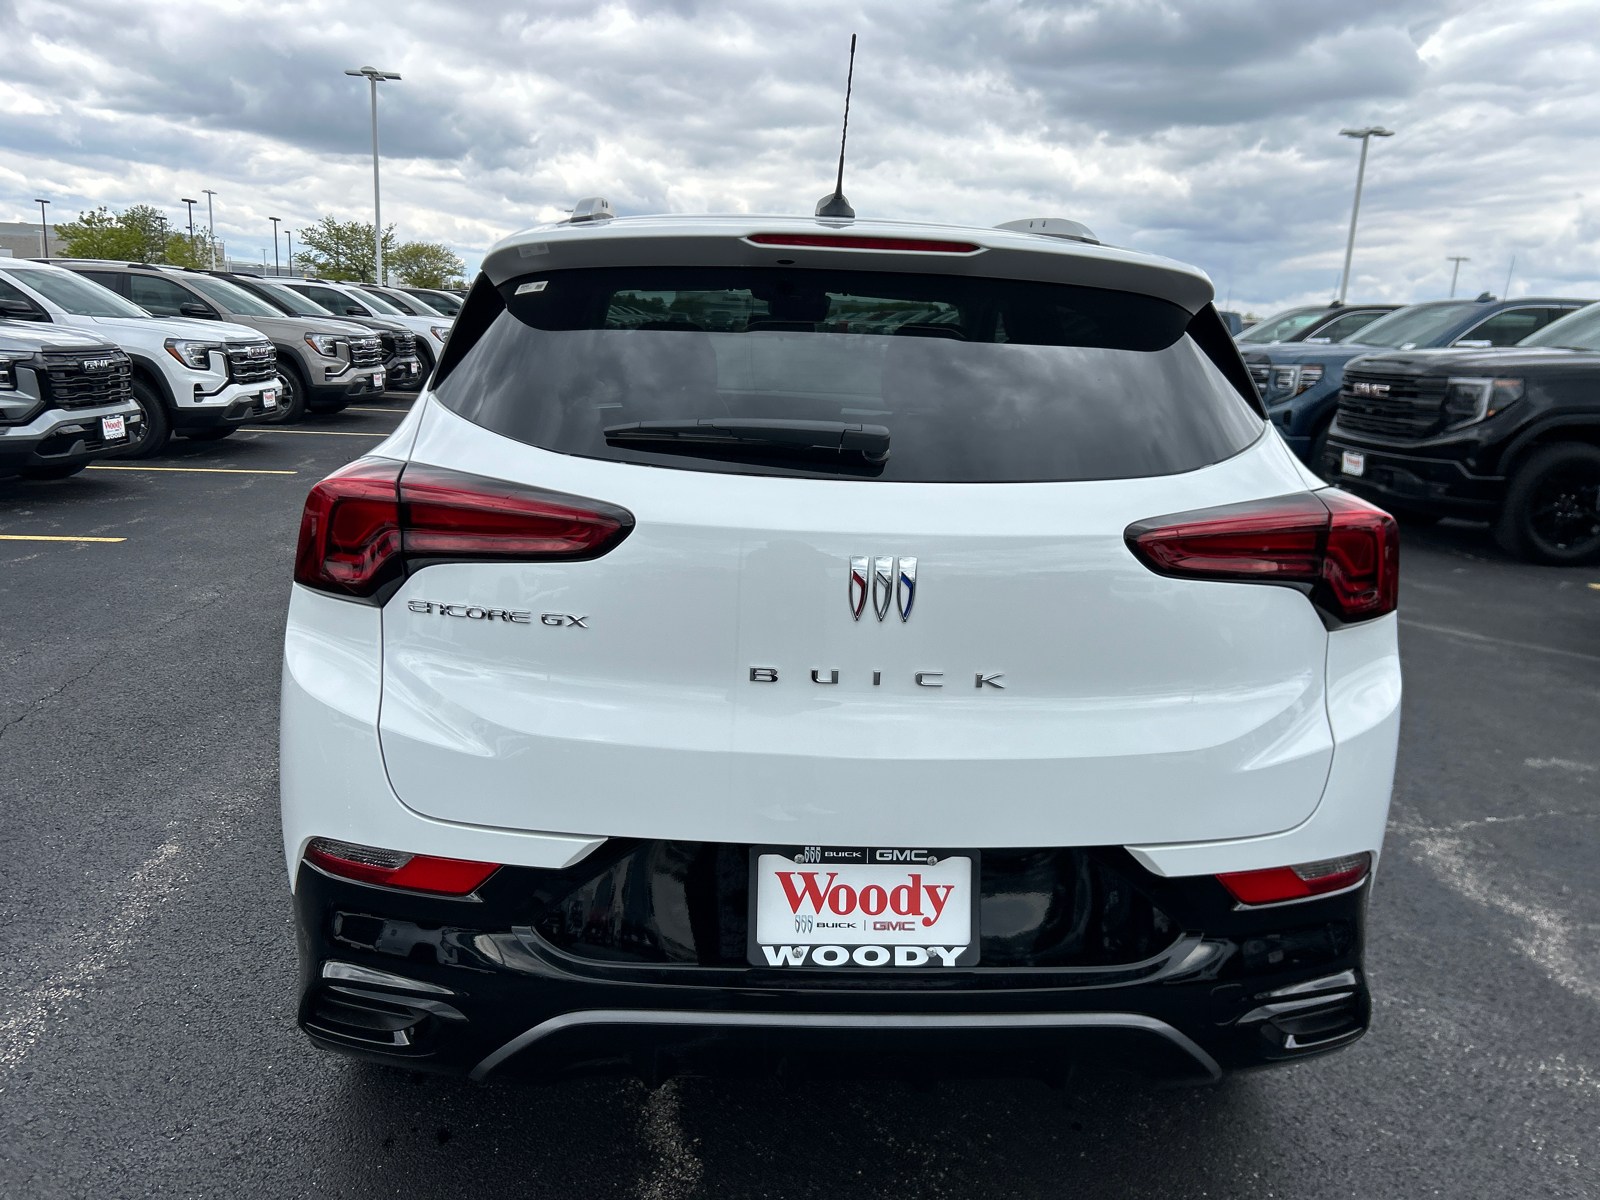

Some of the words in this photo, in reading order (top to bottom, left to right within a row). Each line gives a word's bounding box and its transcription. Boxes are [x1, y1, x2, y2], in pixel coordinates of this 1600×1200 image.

[104, 420, 123, 430] Woody
[407, 599, 531, 624] ENCORE
[541, 612, 590, 629] GX
[749, 667, 1005, 689] BUICK
[876, 850, 928, 861] GMC
[774, 871, 955, 927] Woody
[872, 921, 916, 932] GMC
[761, 945, 968, 967] WOODY
